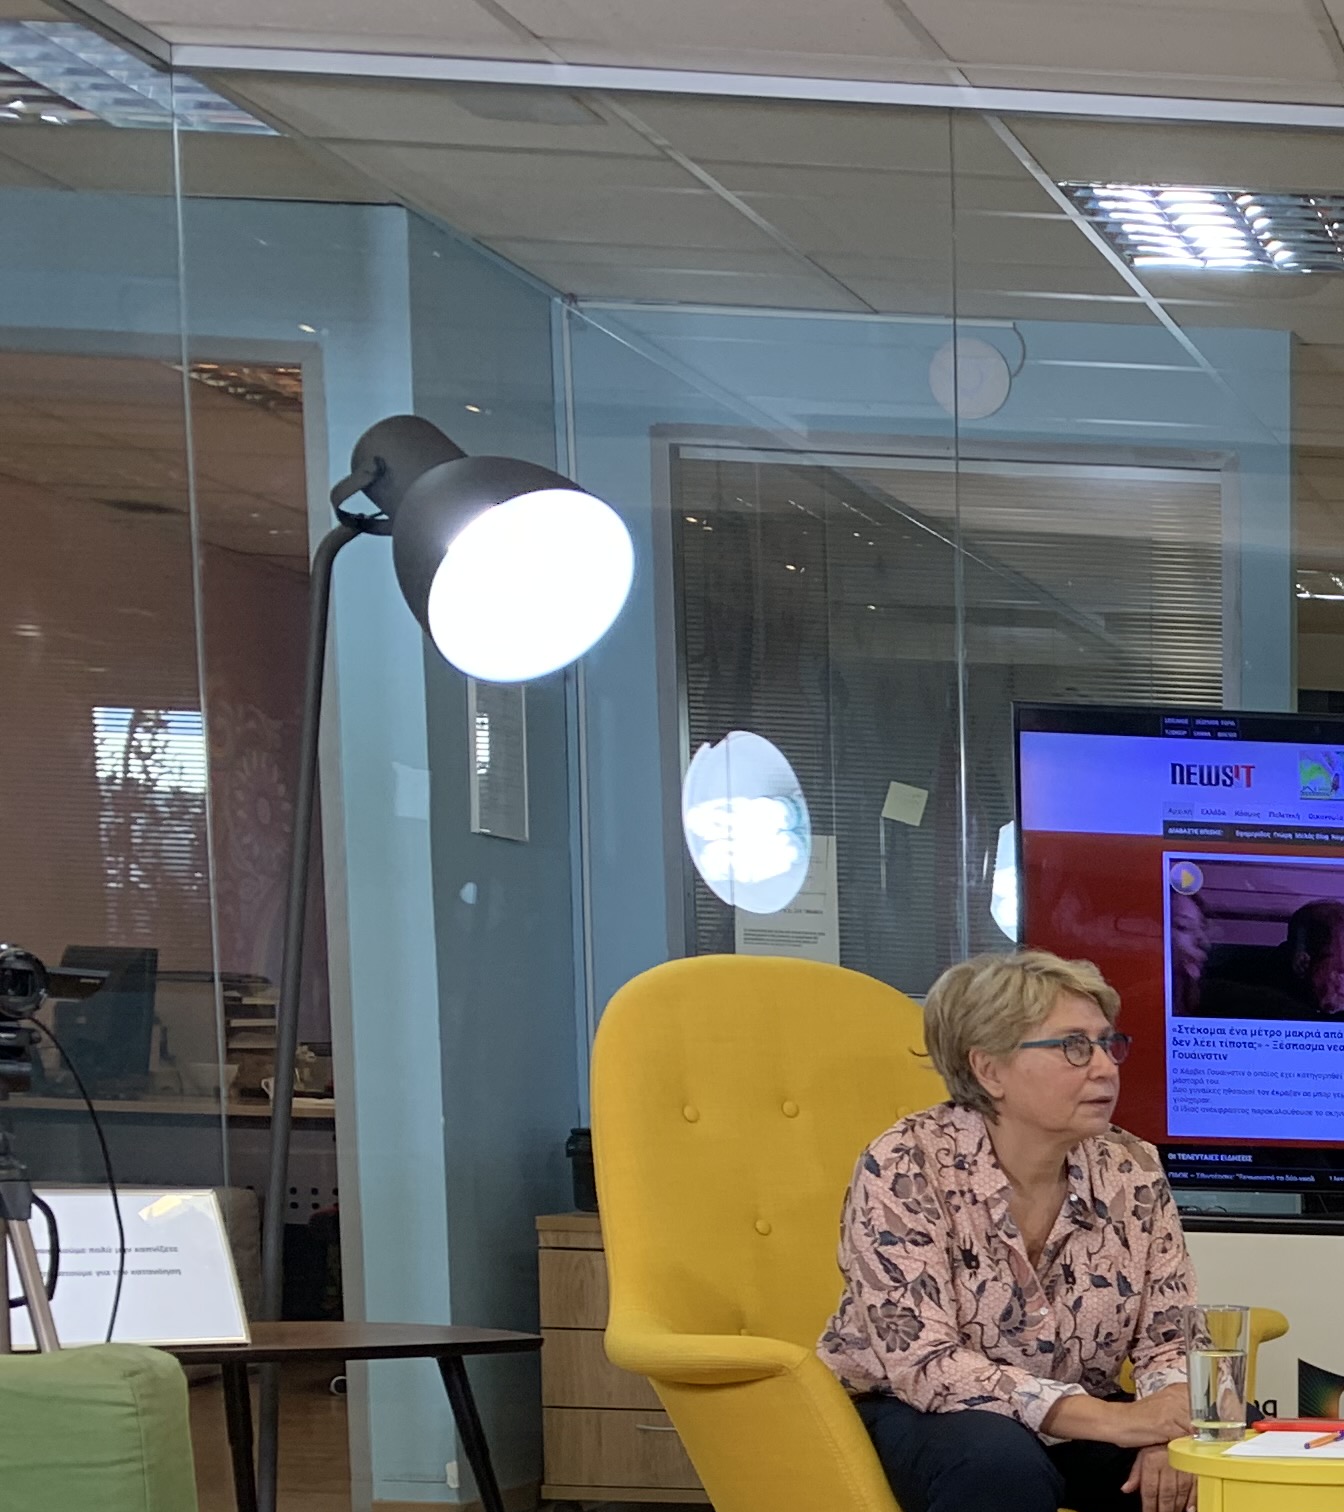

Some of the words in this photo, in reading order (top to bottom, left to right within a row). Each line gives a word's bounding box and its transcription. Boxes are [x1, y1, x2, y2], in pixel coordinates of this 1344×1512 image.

[1229, 1026, 1248, 1036] ένα
[1250, 1027, 1281, 1037] μέτρο
[1284, 1028, 1321, 1039] μακριά
[1172, 1037, 1190, 1047] δεν
